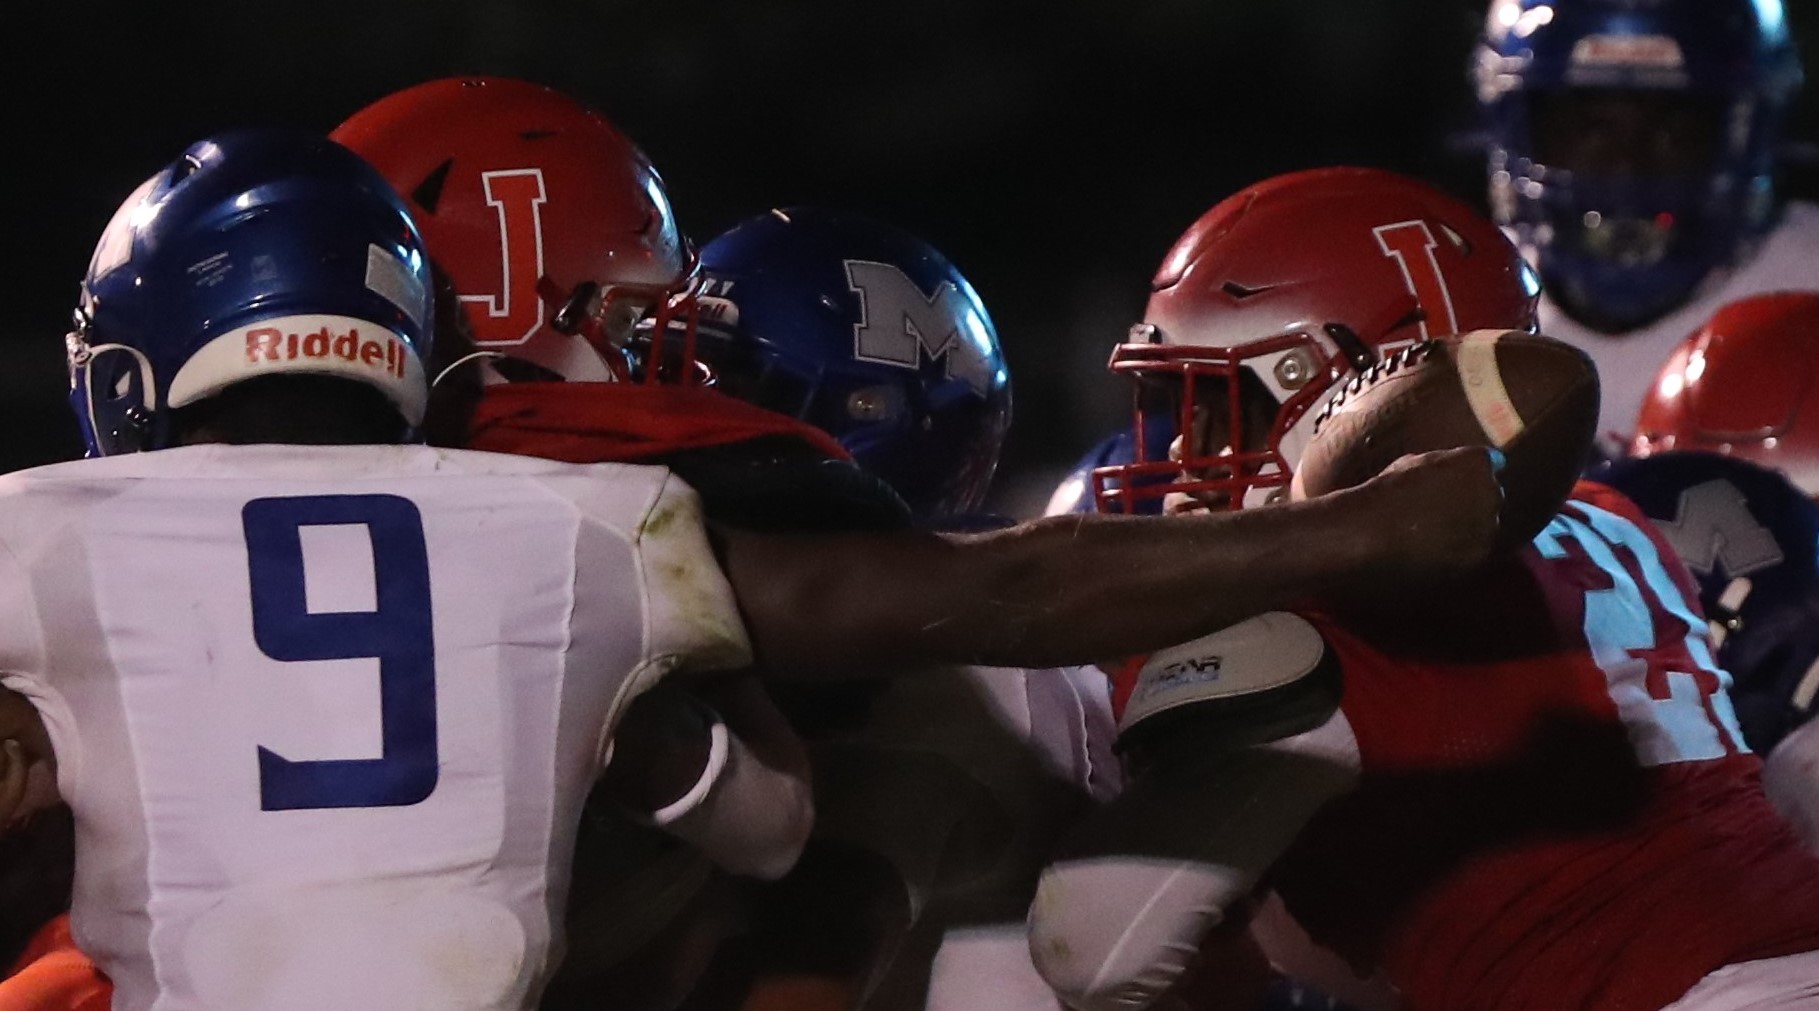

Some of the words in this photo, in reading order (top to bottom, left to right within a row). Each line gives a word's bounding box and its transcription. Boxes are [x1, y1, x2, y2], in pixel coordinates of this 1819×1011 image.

[455, 168, 548, 346] J
[842, 259, 988, 399] M
[245, 326, 405, 379] Riddell
[242, 493, 440, 811] 9
